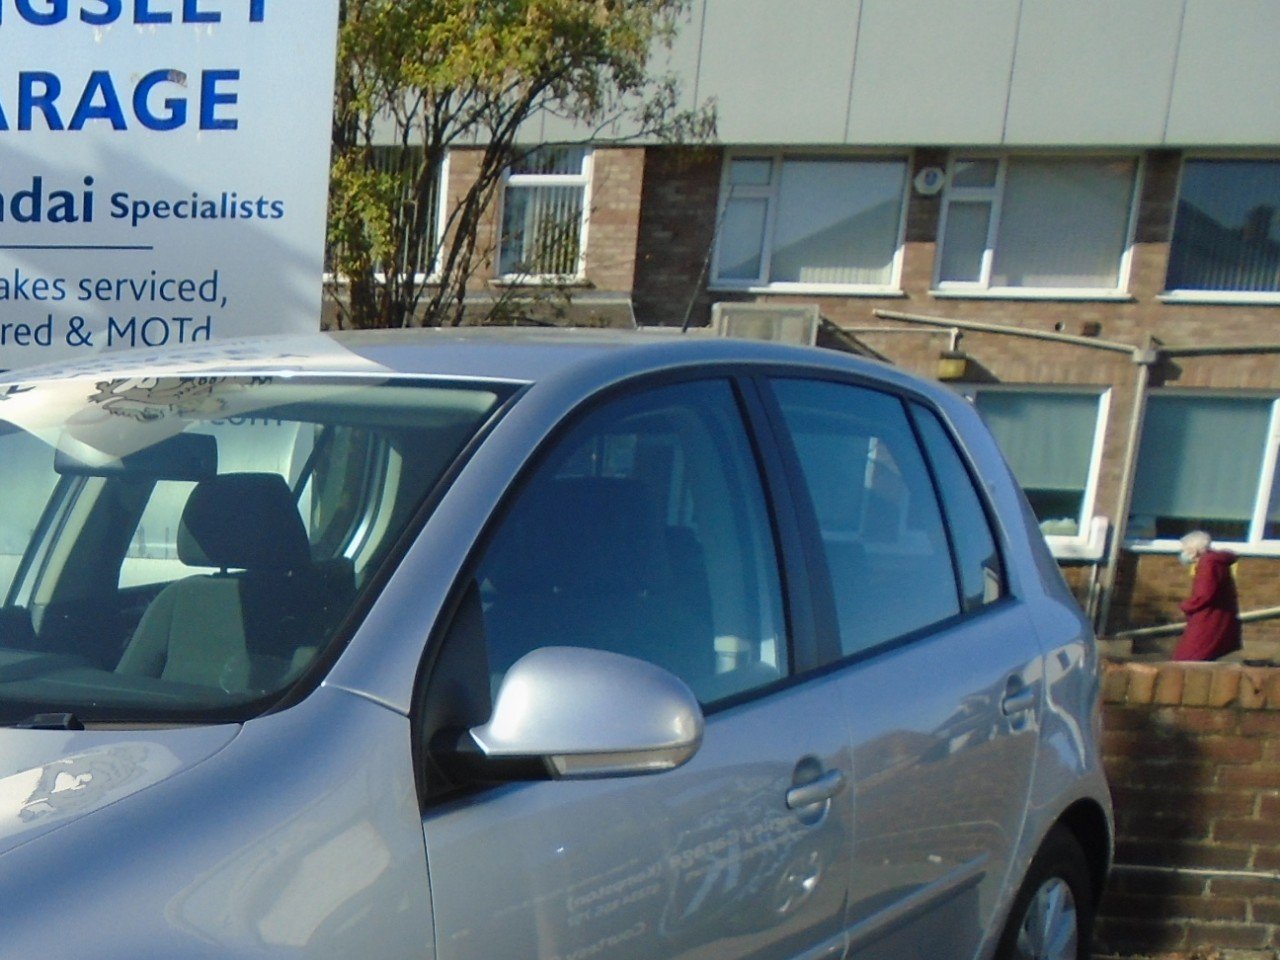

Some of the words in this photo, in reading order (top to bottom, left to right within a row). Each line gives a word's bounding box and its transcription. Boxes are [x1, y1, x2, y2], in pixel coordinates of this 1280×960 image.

[110, 191, 285, 227] Specialists
[78, 270, 227, 308] serviced,
[65, 316, 93, 347] &
[107, 315, 211, 347] MOTd
